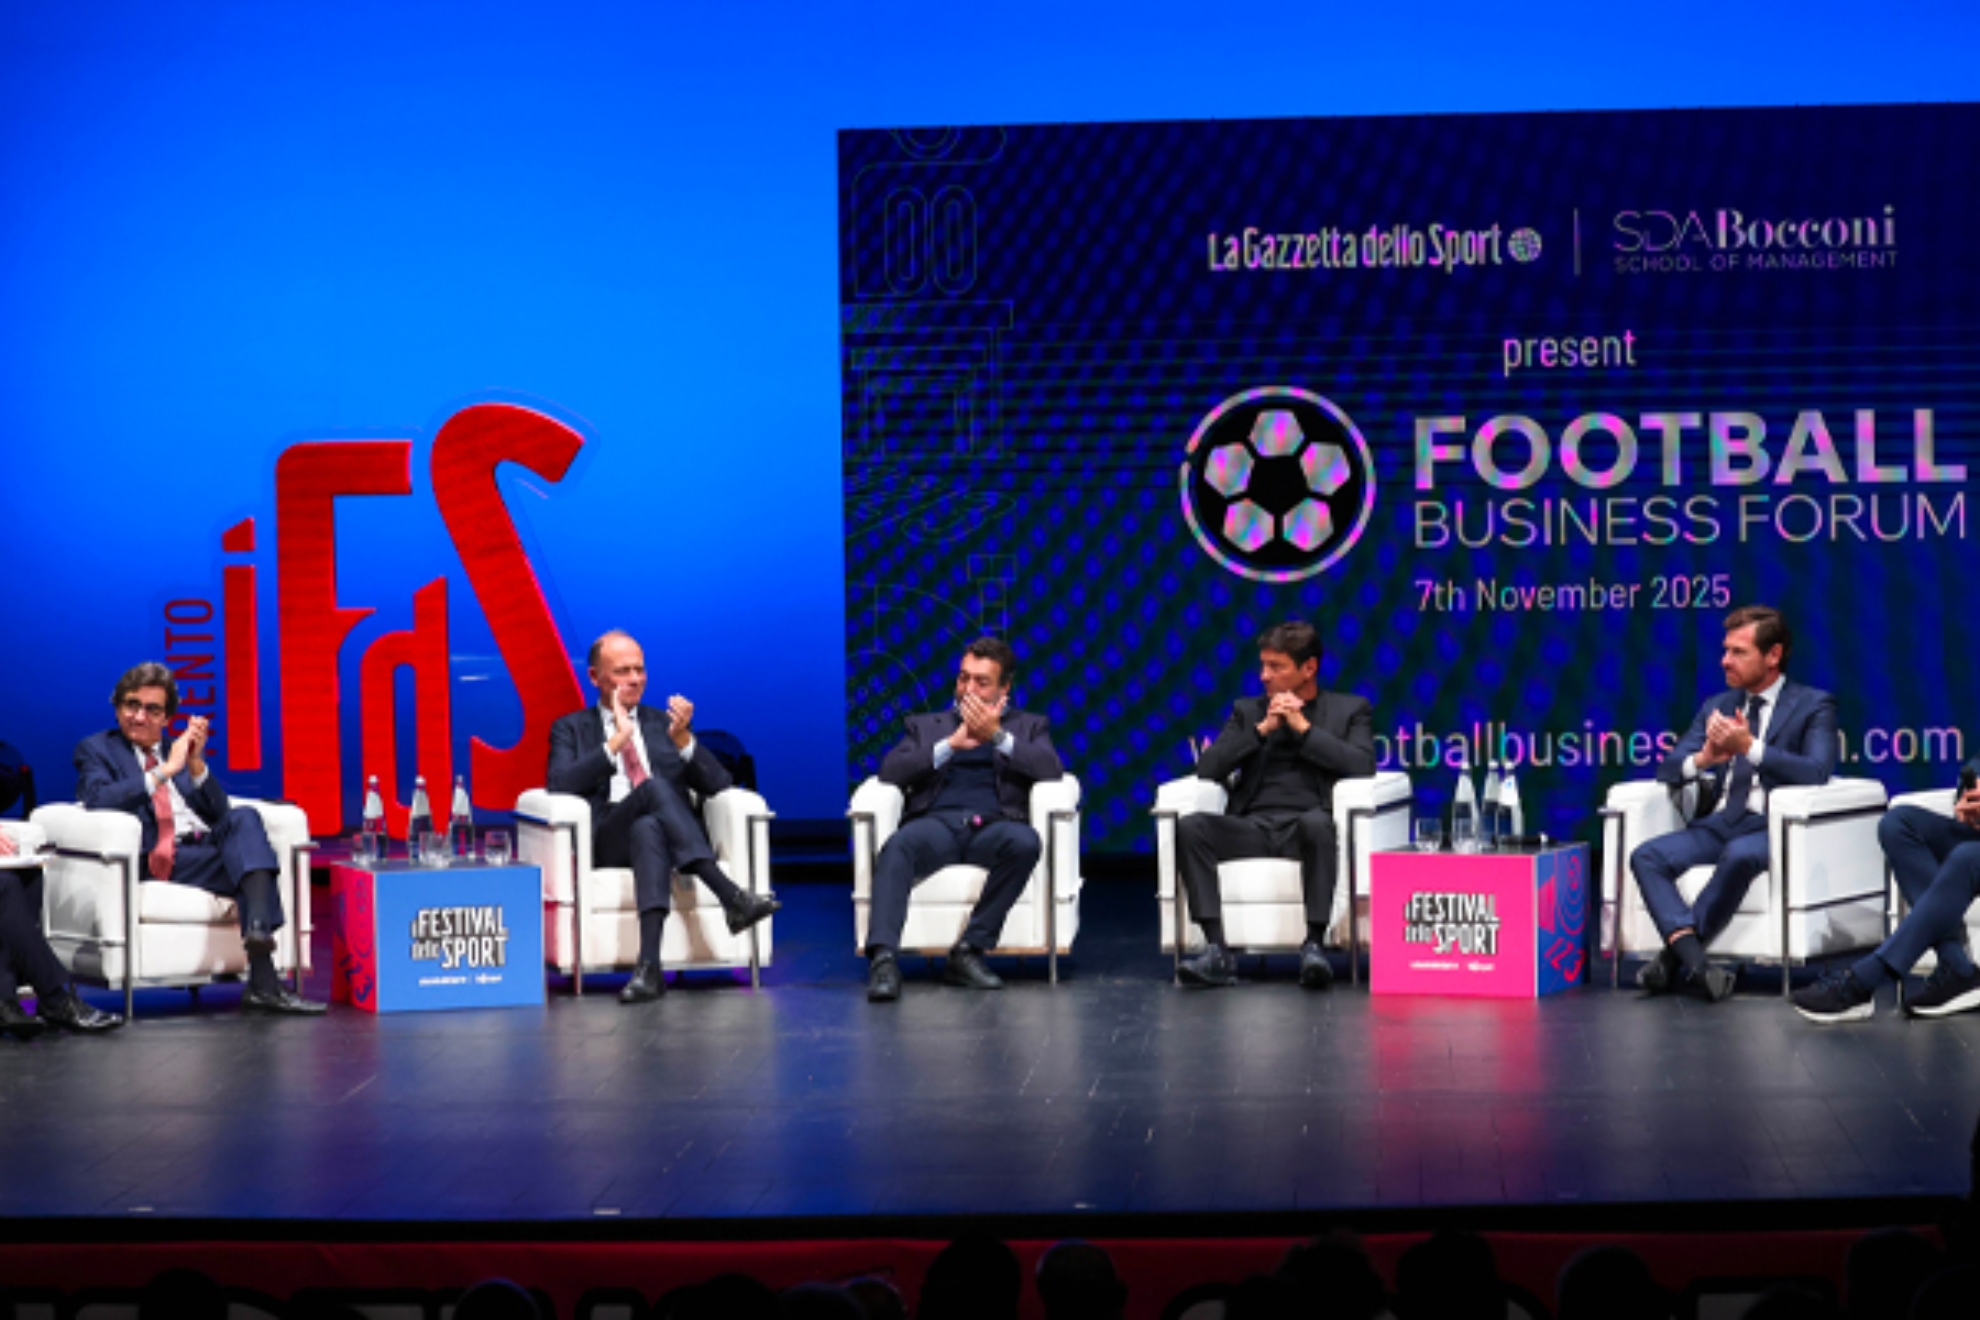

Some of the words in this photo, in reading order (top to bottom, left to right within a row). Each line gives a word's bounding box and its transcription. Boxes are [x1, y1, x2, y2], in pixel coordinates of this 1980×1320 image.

[1207, 231, 1240, 272] La
[1243, 226, 1358, 269] Gazzetta
[1362, 223, 1425, 269] dello
[1428, 222, 1504, 275] Sport
[1613, 253, 1704, 274] SCHOOL
[1709, 252, 1741, 272] OF
[1748, 249, 1898, 271] MANAGEMENT
[1503, 328, 1637, 377] present
[1414, 408, 1969, 491] FOOTBALL
[1414, 493, 1721, 549] BUSINESS
[1738, 491, 1967, 544] FORUM
[1414, 578, 1467, 612] 7th
[1475, 575, 1641, 611] November
[1650, 573, 1732, 608] 2025
[164, 598, 217, 758] RENTO
